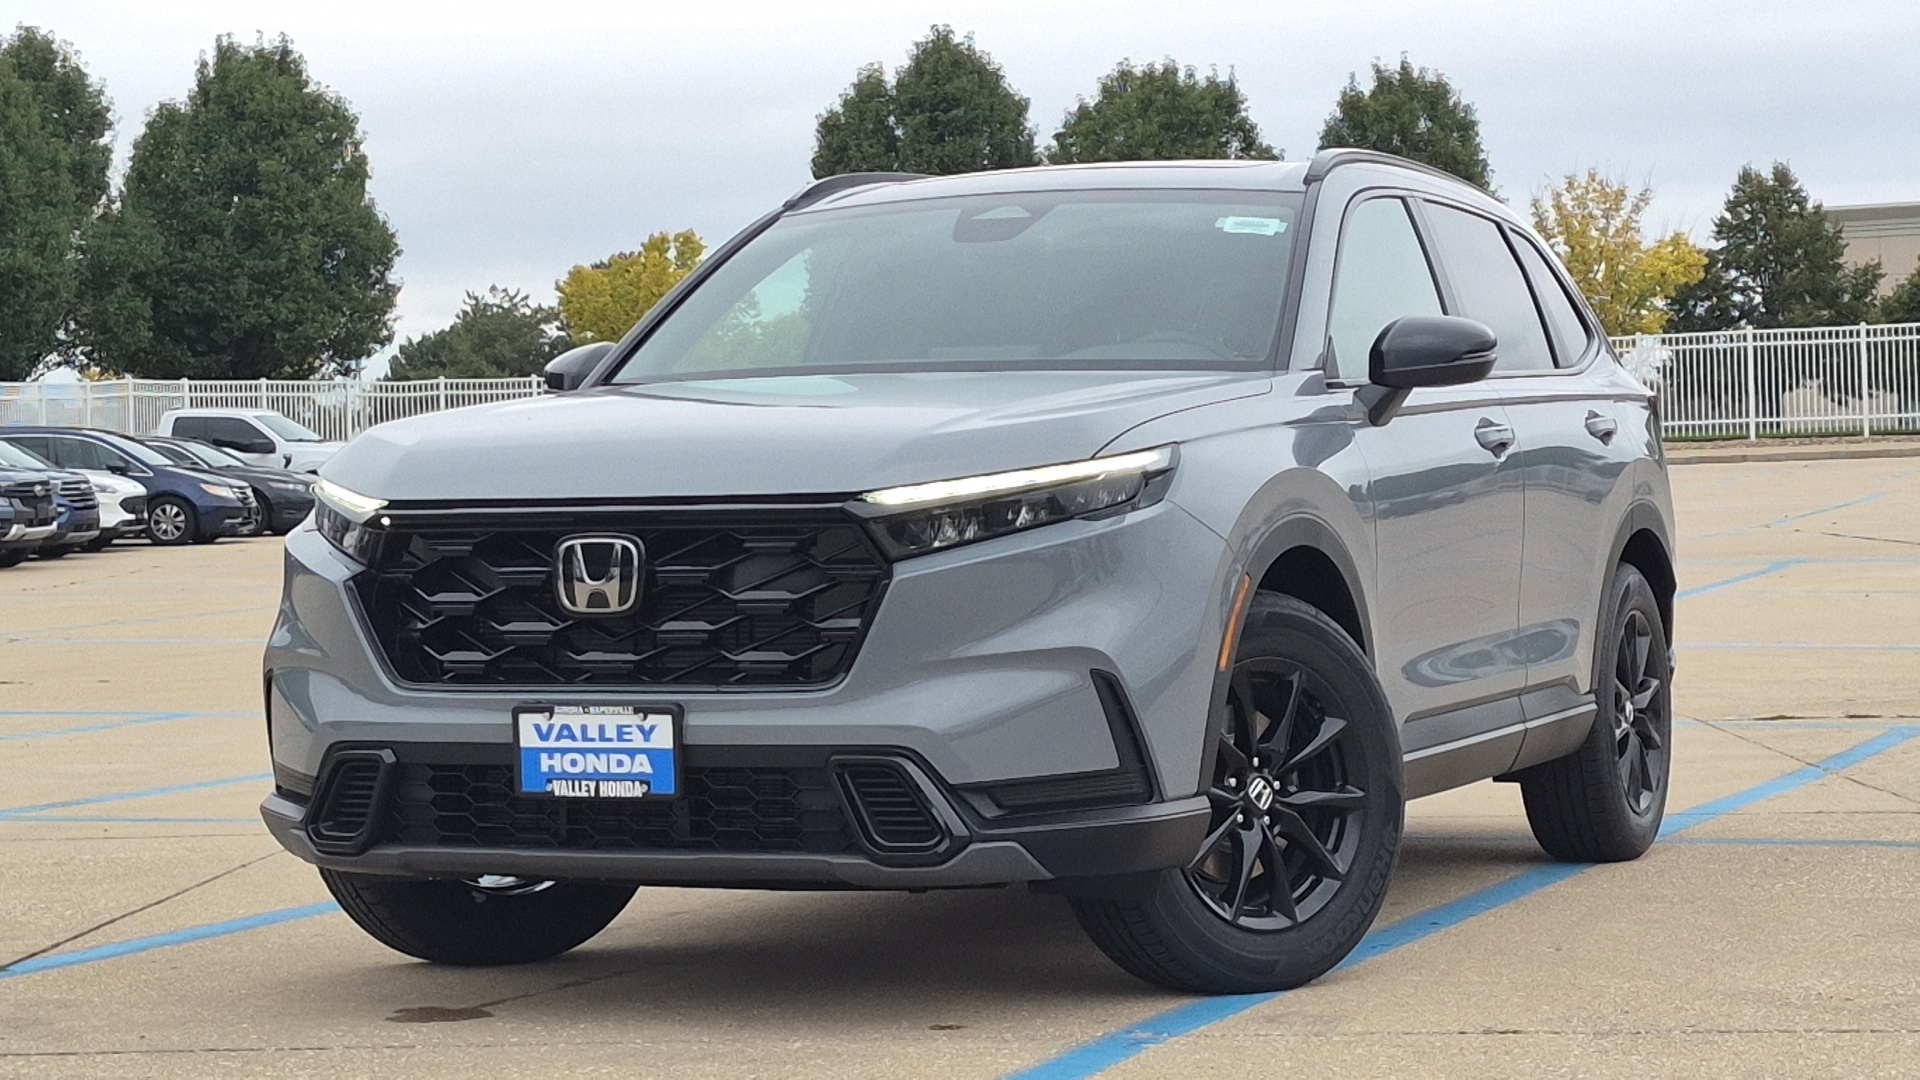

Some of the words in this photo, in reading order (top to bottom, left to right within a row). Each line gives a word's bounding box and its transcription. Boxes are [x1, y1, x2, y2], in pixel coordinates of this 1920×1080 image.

[533, 723, 657, 742] VALLEY
[540, 752, 654, 774] HONDA
[552, 780, 596, 797] VALLEY
[599, 781, 643, 798] HONDA
